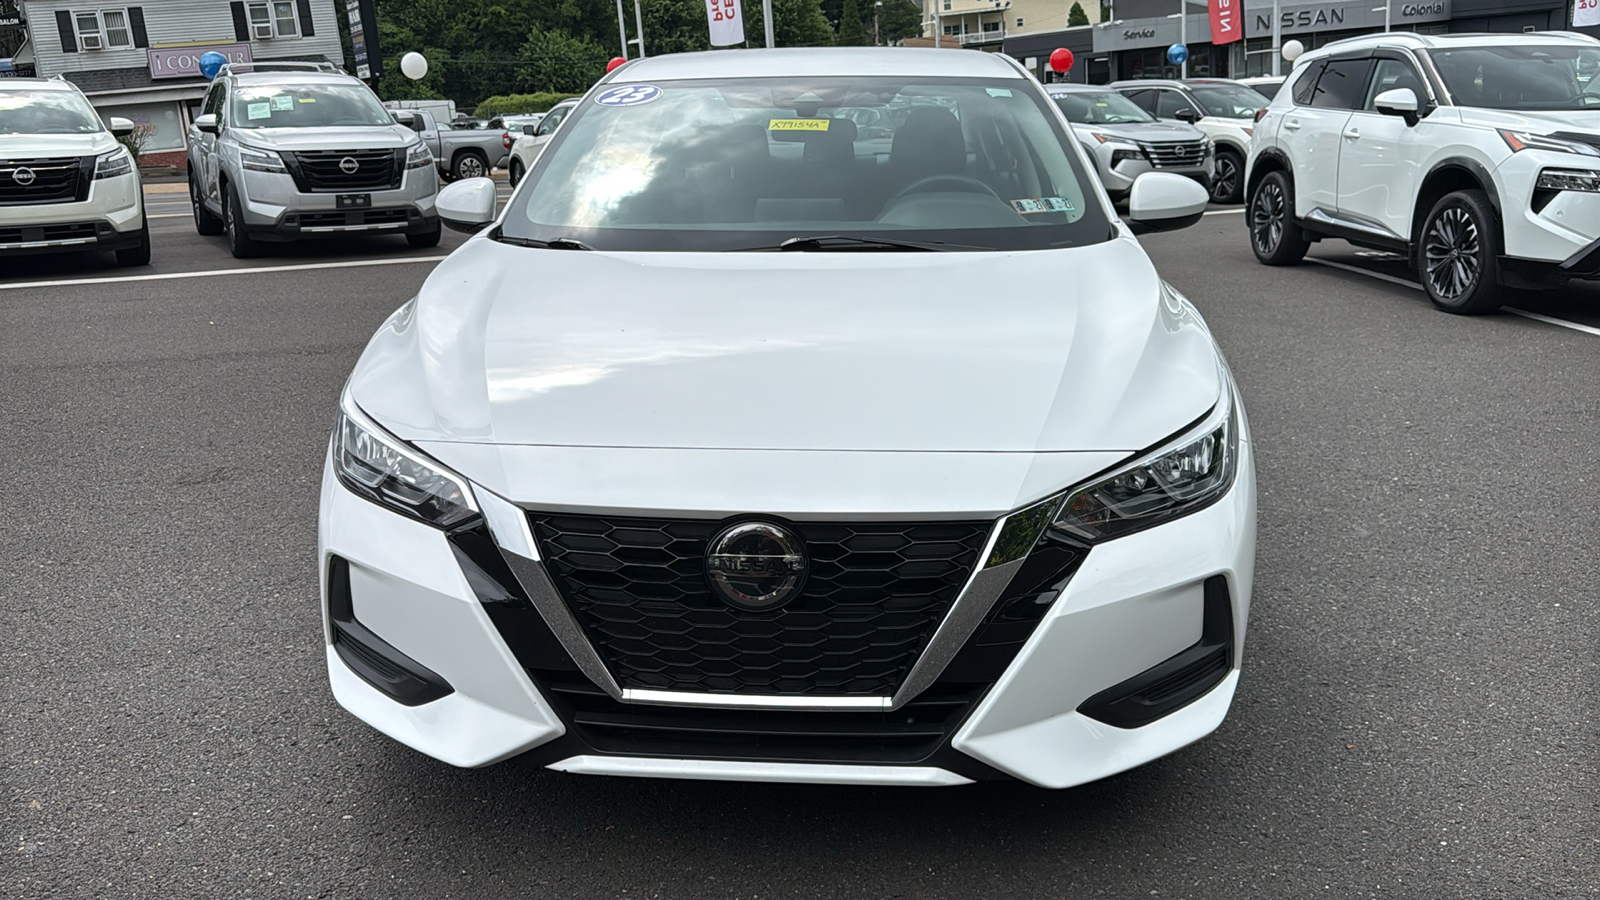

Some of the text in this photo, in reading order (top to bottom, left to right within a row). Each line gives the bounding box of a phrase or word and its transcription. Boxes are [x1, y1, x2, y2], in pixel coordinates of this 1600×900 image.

[1402, 2, 1445, 17] Colonial
[1256, 8, 1344, 31] NSSAN
[1123, 28, 1155, 40] Service
[601, 87, 655, 103] 23
